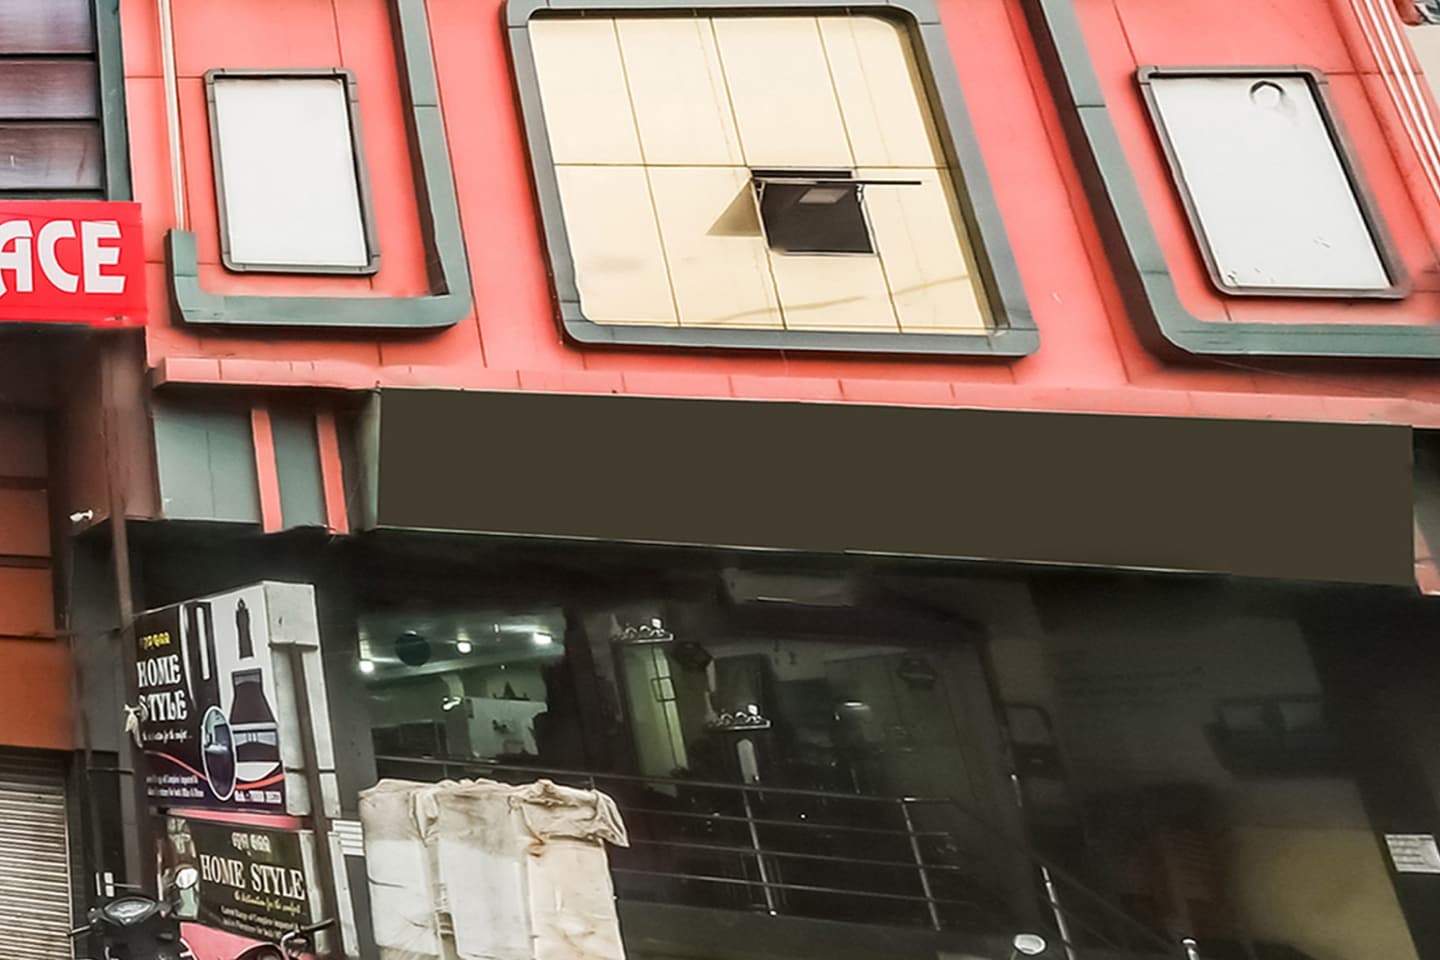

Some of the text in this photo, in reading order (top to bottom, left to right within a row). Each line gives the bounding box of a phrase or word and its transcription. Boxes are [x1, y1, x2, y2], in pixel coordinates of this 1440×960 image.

[137, 654, 180, 688] HOME
[139, 690, 187, 722] STYLE
[200, 854, 305, 900] HOME STYLE
